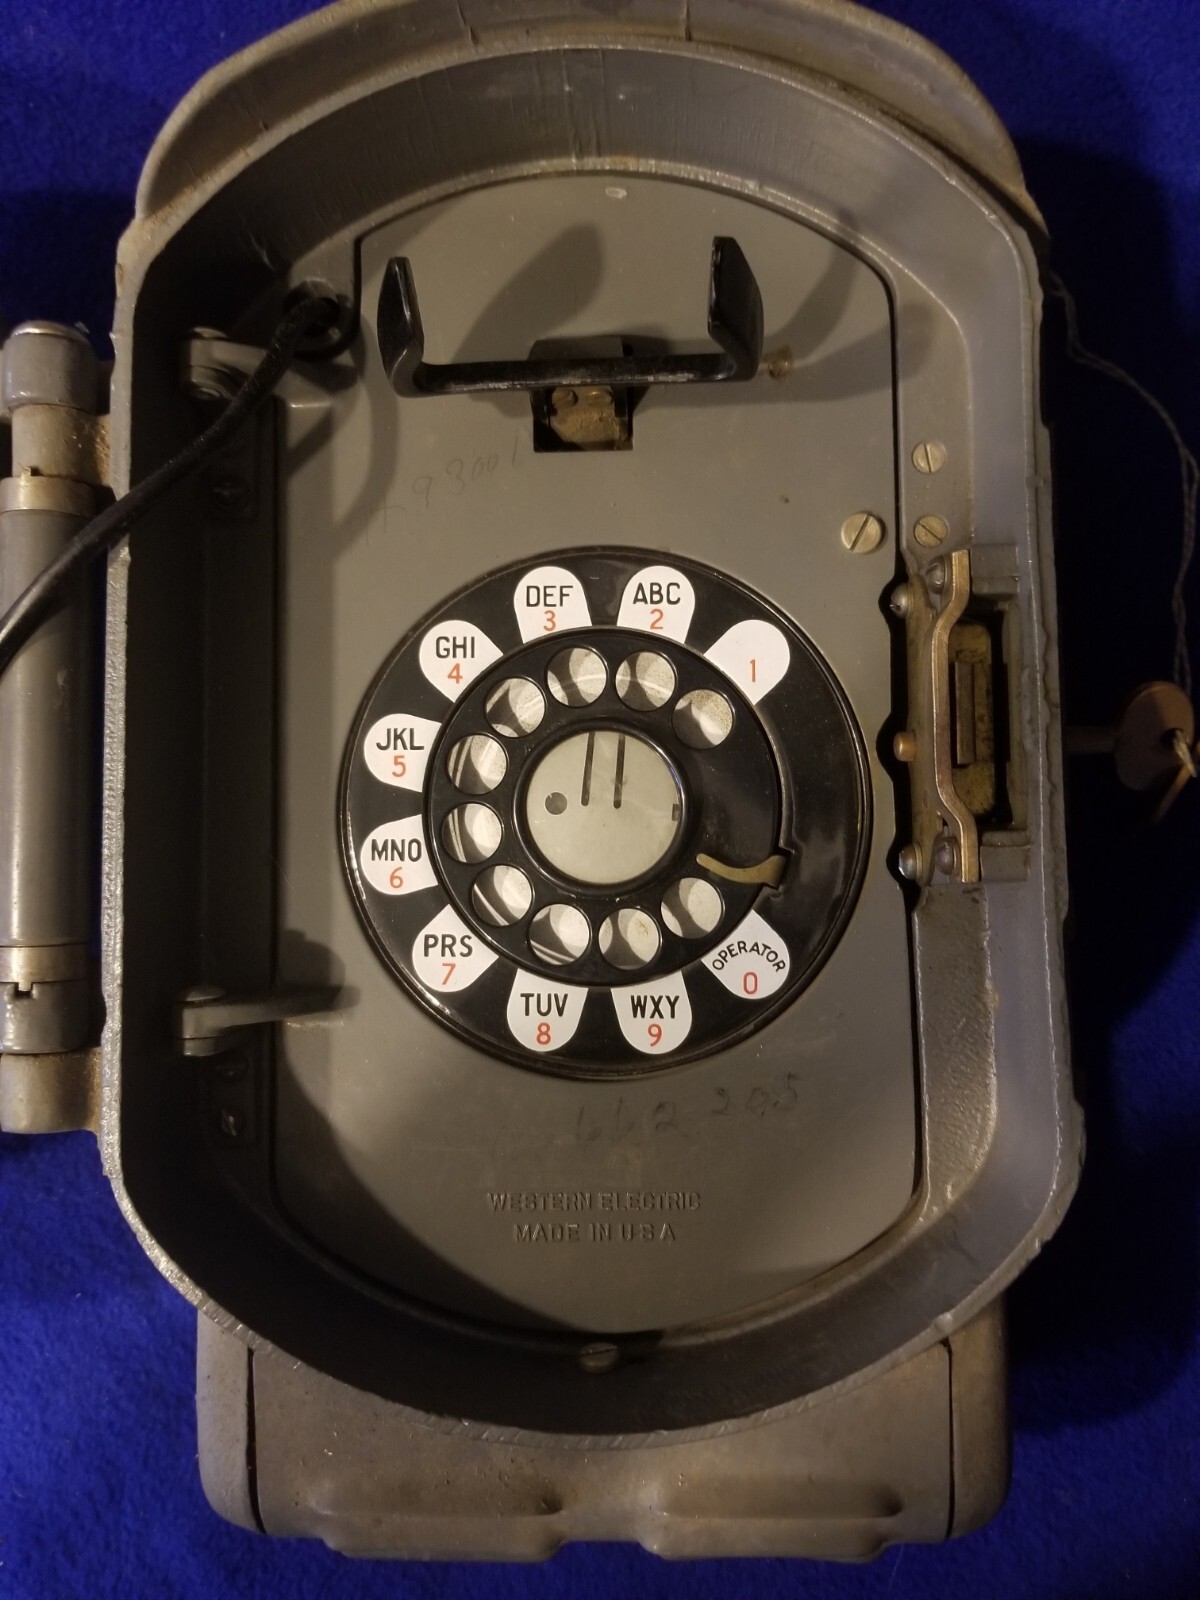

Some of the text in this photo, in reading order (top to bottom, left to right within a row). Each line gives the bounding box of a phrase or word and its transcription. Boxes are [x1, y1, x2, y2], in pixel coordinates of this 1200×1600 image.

[525, 585, 574, 607] DEF
[632, 581, 681, 605] ABC
[543, 610, 557, 631] 3
[649, 608, 664, 630] 2
[435, 636, 476, 659] GHI
[447, 663, 463, 684] 4
[748, 659, 757, 683] 1
[376, 728, 424, 751] JKL
[392, 754, 407, 777] 5
[371, 838, 422, 863] MNO
[389, 868, 404, 889] 6
[422, 933, 474, 958] PRS
[711, 938, 787, 973] OPERATOR
[441, 963, 456, 985] 7
[743, 972, 758, 994] 0
[520, 992, 569, 1018] TUV
[630, 994, 680, 1020] WXY
[536, 1022, 551, 1046] 8
[647, 1023, 663, 1046] 9
[487, 1191, 701, 1212] WESTERN ELECTRIC
[513, 1222, 580, 1243] MADE
[589, 1222, 612, 1243] IN
